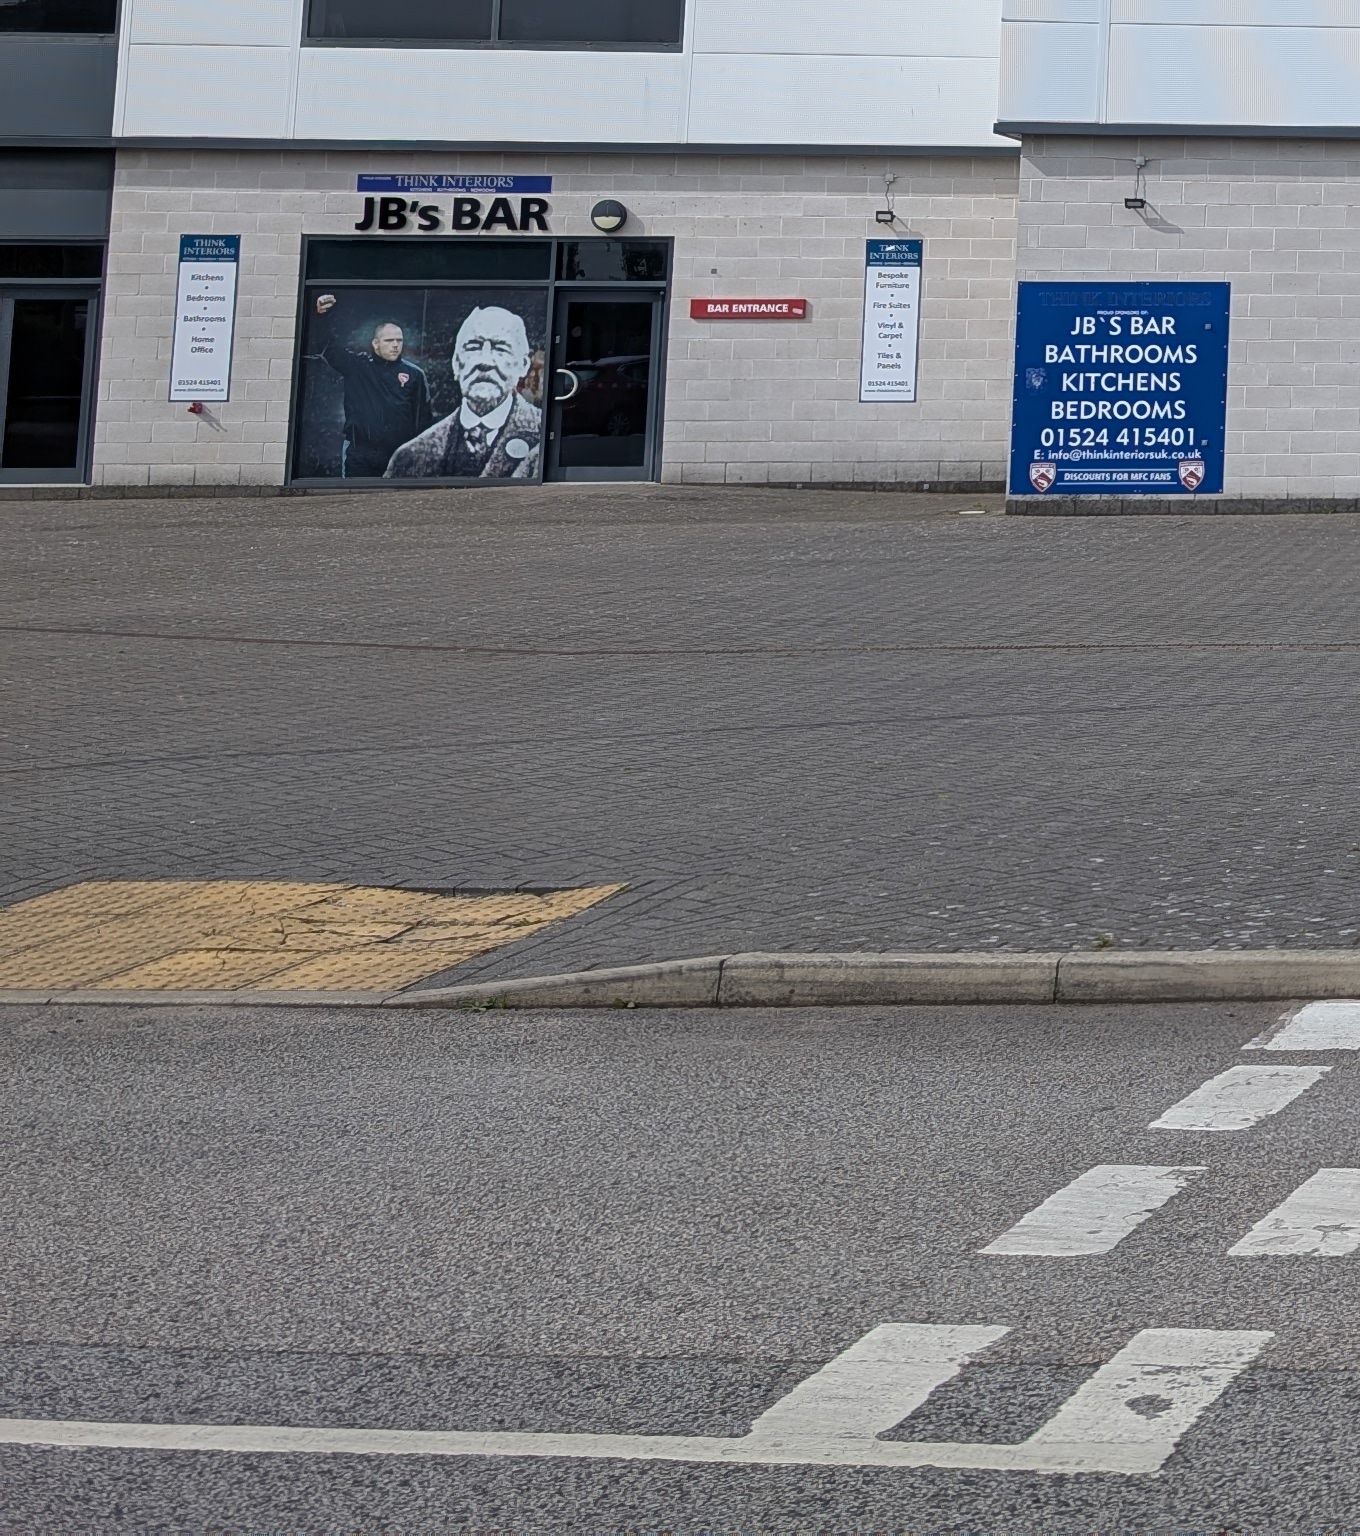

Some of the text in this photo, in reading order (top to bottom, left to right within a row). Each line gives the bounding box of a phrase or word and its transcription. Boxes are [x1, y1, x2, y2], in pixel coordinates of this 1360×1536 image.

[395, 175, 514, 188] THINK INTERIORS
[355, 197, 549, 231] JB's BAR
[194, 239, 226, 247] THINK
[183, 247, 236, 255] INTERIORS
[869, 252, 919, 260] INTERIORS
[878, 271, 909, 279] Bespoke
[707, 304, 789, 313] BAR ENTRANCE
[1130, 317, 1176, 335] BAR
[1045, 344, 1198, 364] BATHROOMS
[1061, 372, 1181, 392] KITCHENS
[1051, 400, 1186, 420] BEDROOMS
[1040, 427, 1195, 447] 01524 415401
[1034, 449, 1202, 461] E: info@thinkinteriorsuk.co.uk
[1064, 472, 1110, 481] DISCOUNTS
[1150, 472, 1172, 480] FANS
